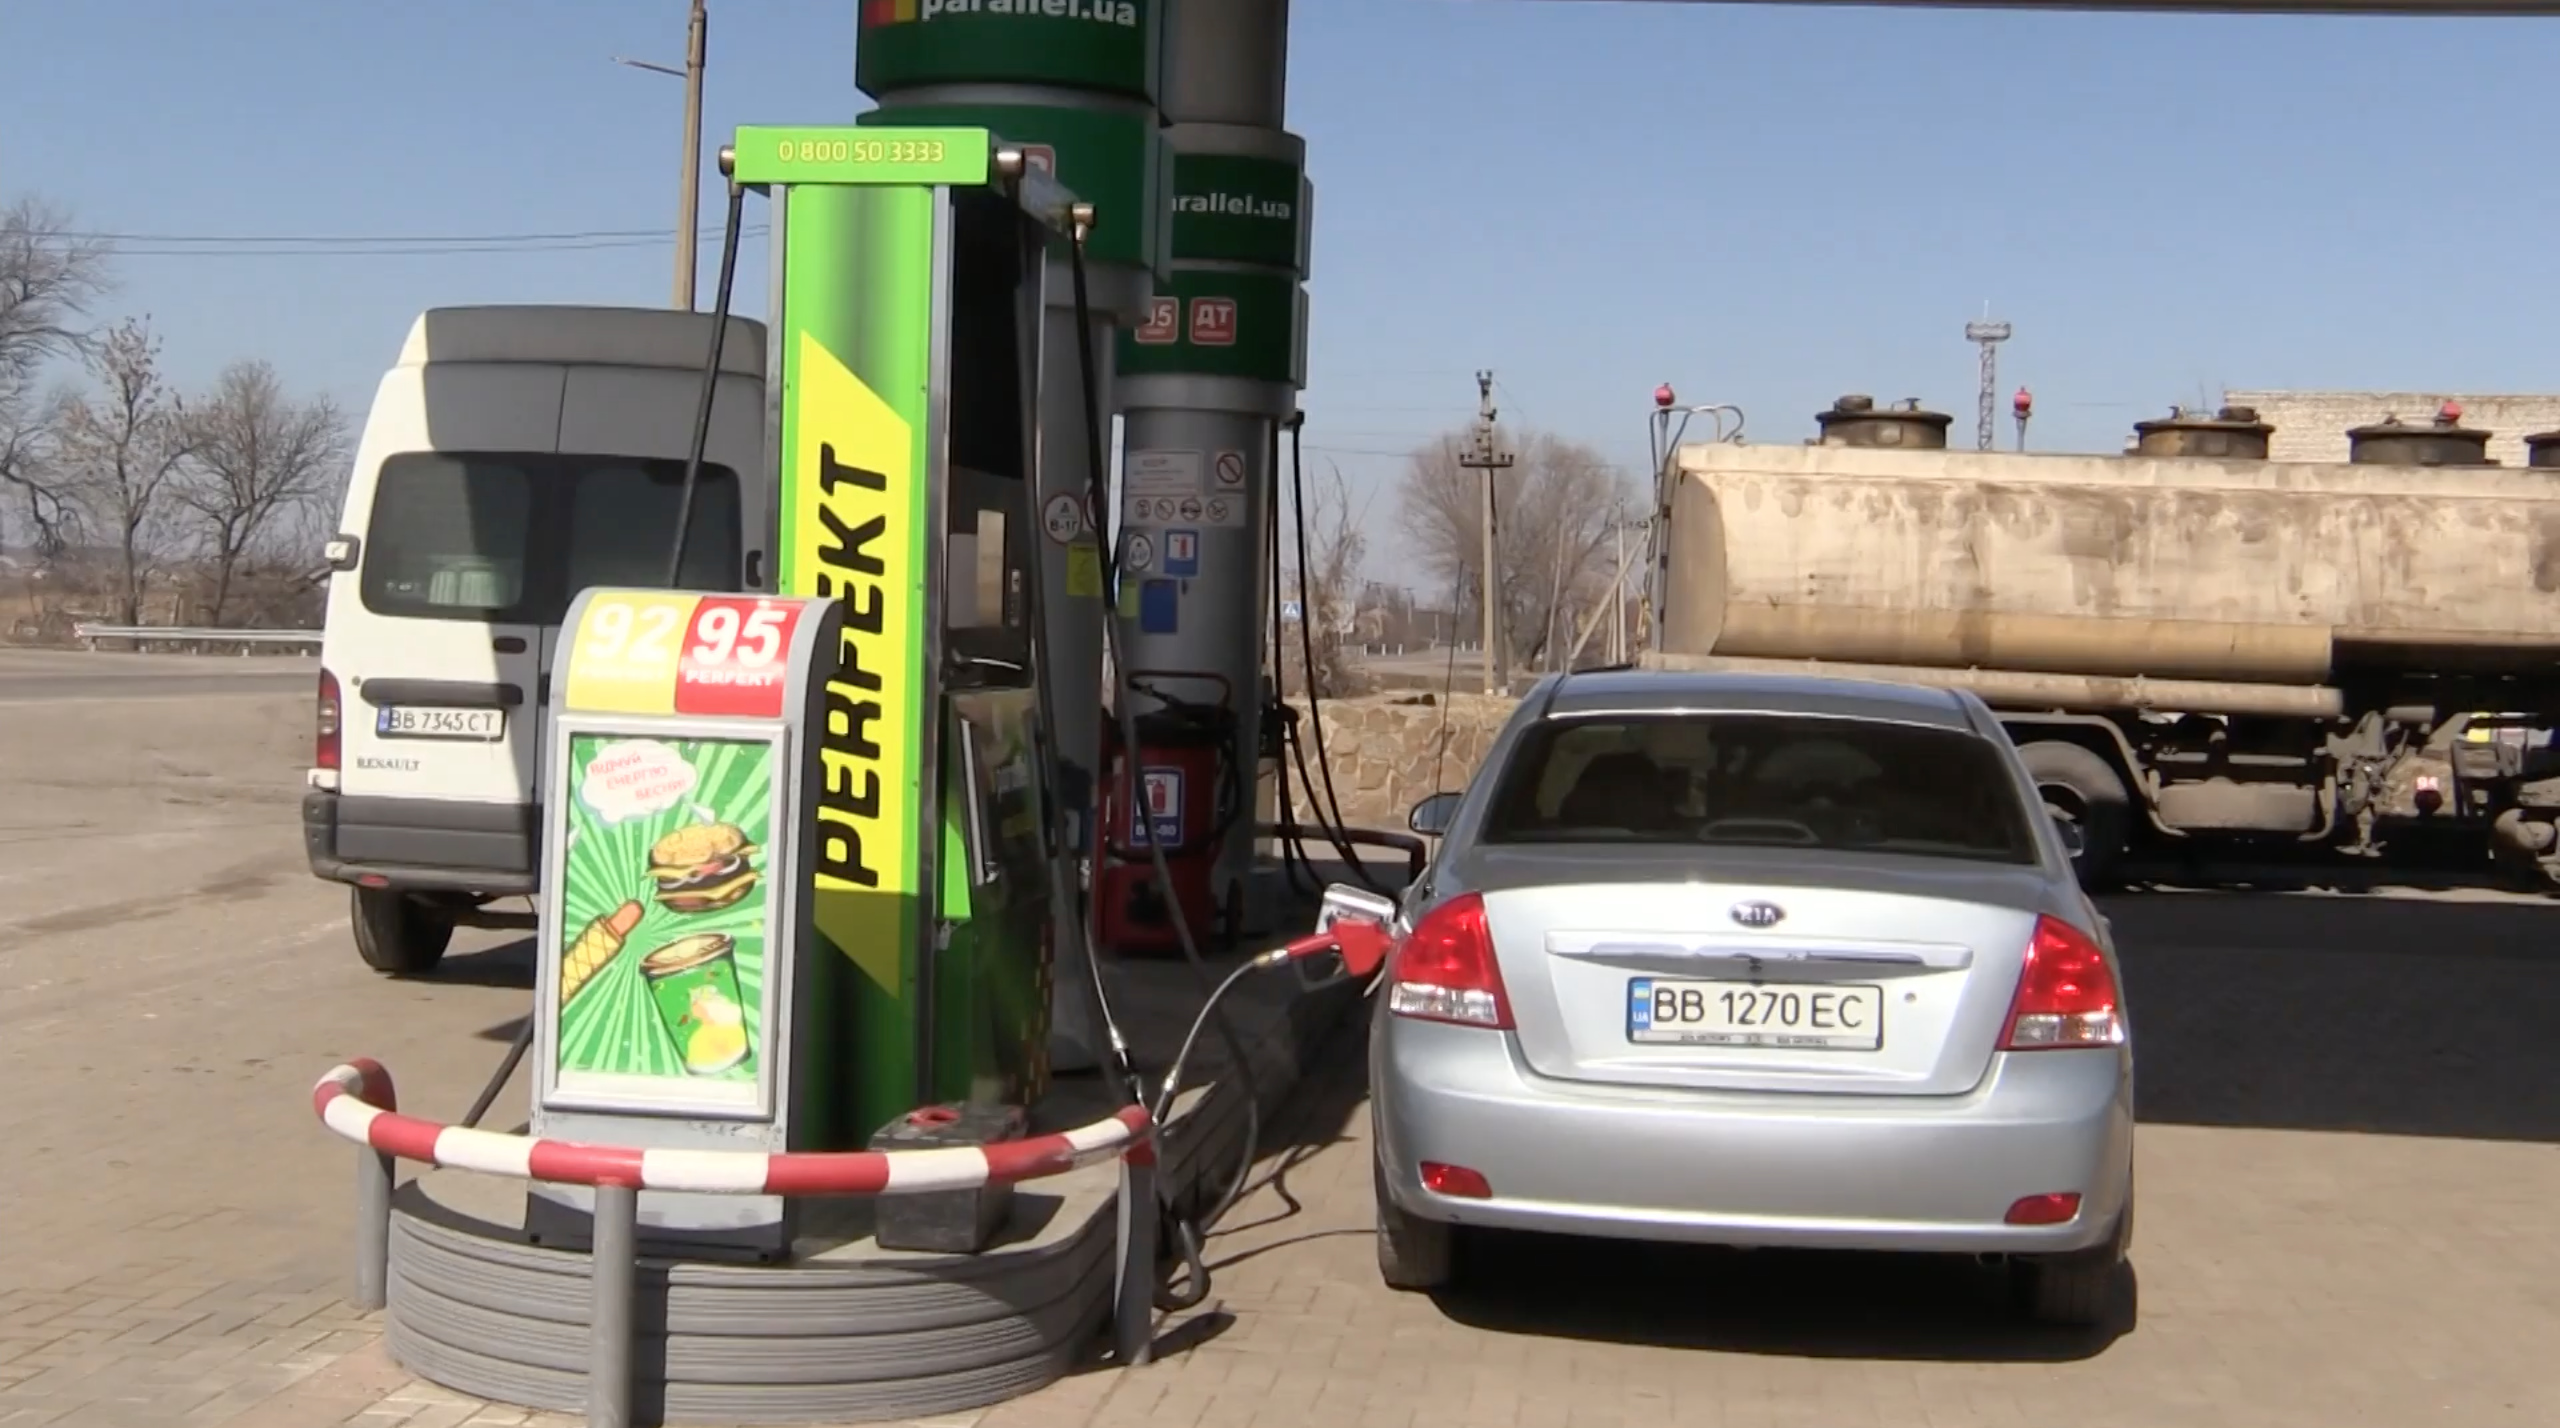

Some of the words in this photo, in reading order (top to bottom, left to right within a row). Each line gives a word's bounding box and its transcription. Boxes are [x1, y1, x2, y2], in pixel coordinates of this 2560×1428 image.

[778, 140, 794, 162] 0
[800, 140, 847, 162] 800
[854, 140, 883, 162] 50
[889, 140, 943, 162] 3333
[1172, 192, 1291, 220] rallel.ua
[1195, 303, 1233, 329] ДТ
[585, 602, 679, 663] 92
[692, 606, 788, 668] 95
[816, 441, 887, 888] PERFEKT
[685, 669, 775, 687] PERFEKT
[390, 712, 416, 730] BB
[421, 713, 464, 732] 7345
[468, 713, 493, 732] CT
[357, 756, 421, 771] RENAULT
[1738, 906, 1777, 922] KIA
[1633, 1011, 1649, 1023] UA
[1653, 987, 1705, 1024] BB
[1719, 990, 1800, 1026] 1270
[1811, 994, 1863, 1029] EC
